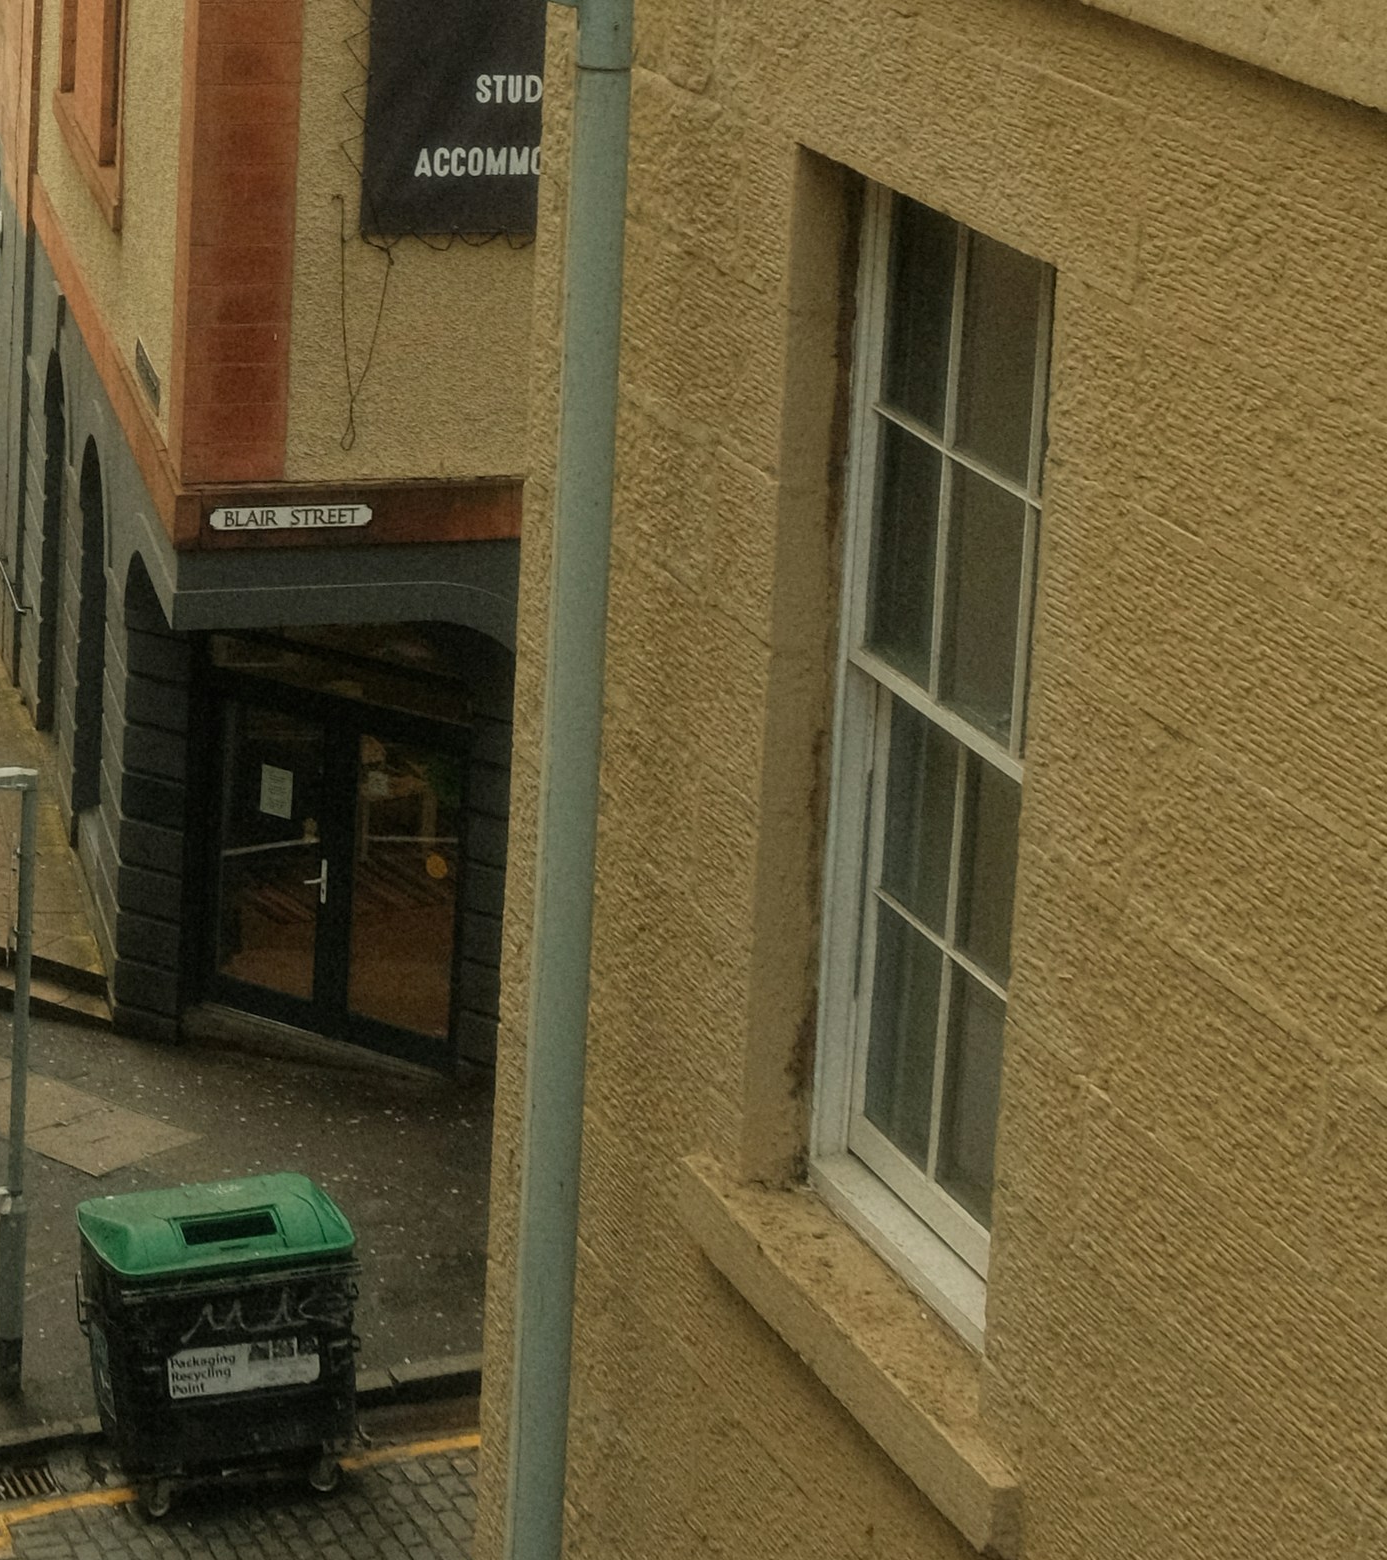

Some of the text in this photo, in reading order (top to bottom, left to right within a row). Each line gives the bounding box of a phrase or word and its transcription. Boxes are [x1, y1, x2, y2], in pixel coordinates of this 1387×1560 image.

[224, 507, 360, 527] BLAIR STREET
[170, 1354, 236, 1370] Packaging
[170, 1368, 232, 1383] Recycling
[171, 1383, 205, 1395] Point
